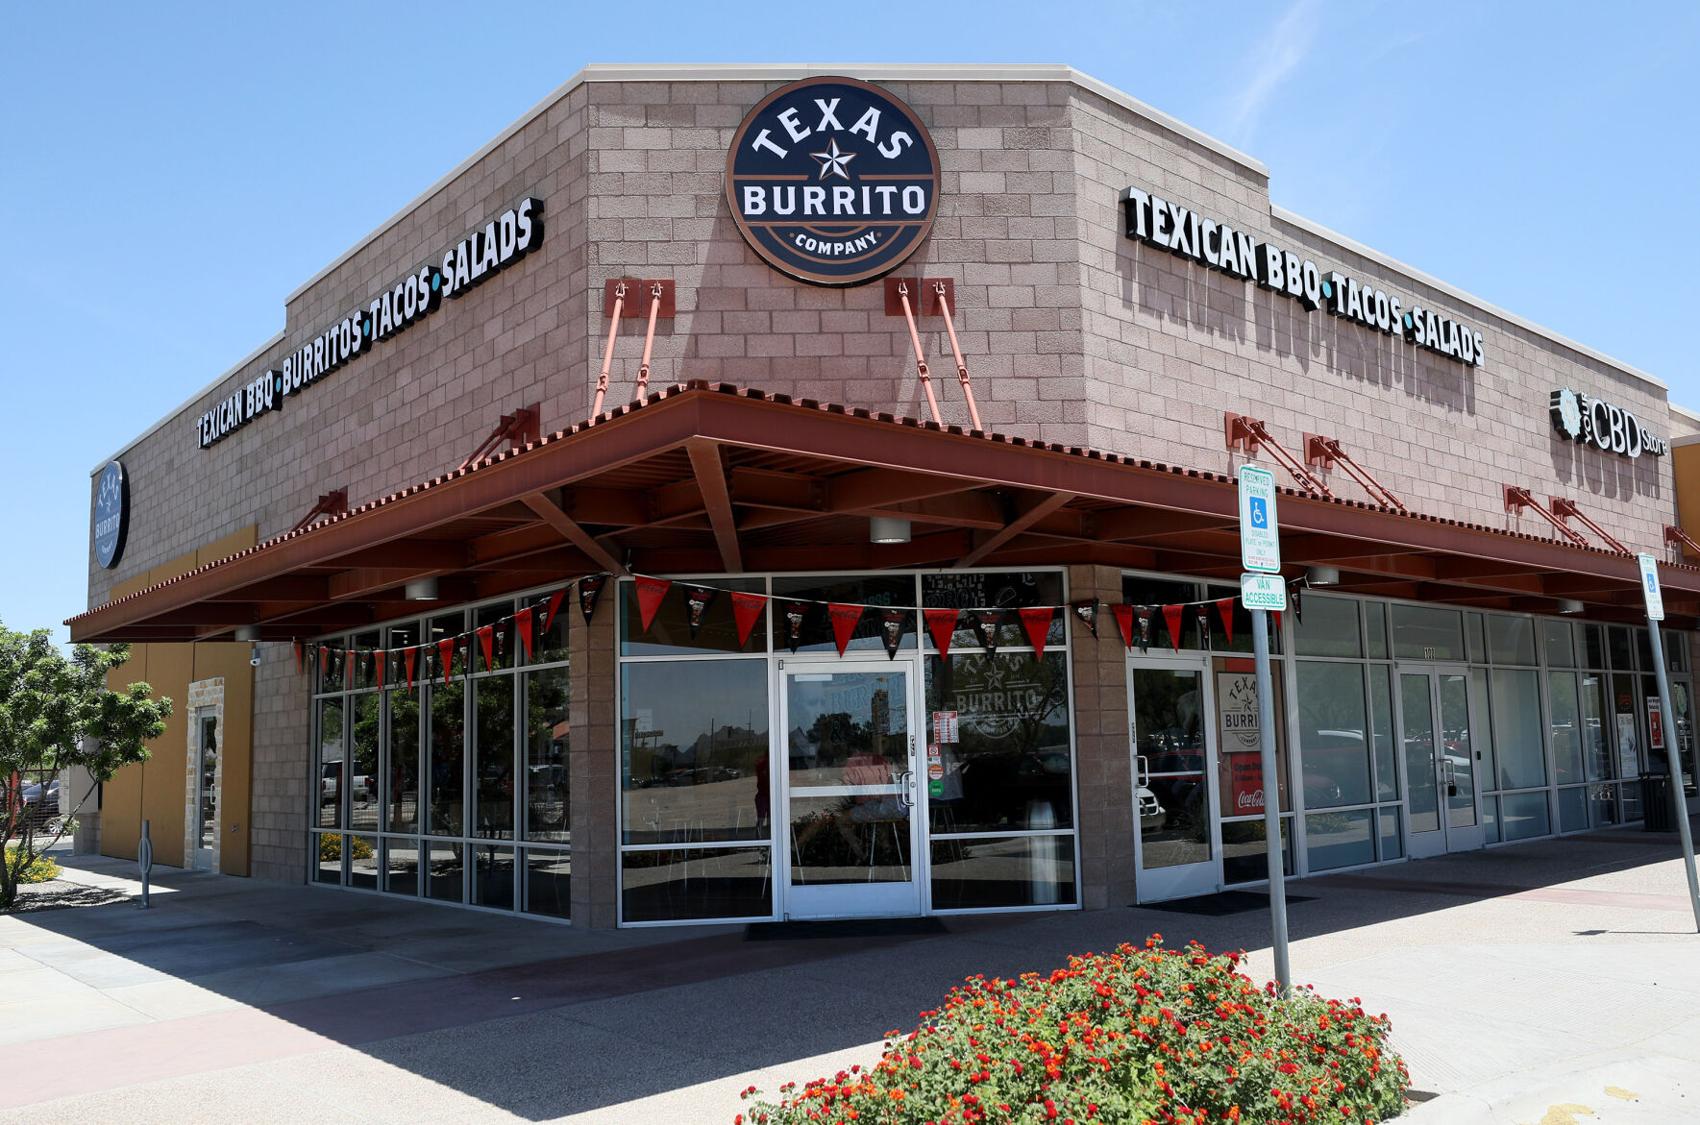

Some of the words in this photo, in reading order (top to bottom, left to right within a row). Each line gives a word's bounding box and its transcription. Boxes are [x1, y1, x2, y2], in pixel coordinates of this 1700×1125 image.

[752, 98, 914, 159] TEXAS
[743, 185, 926, 215] BURRITO
[795, 231, 878, 256] COMPANY
[1128, 186, 1258, 281] TEXICAN
[1265, 243, 1322, 310] BBQ
[1332, 272, 1402, 335] TACOS
[1411, 306, 1485, 367] SALADS
[196, 389, 243, 449] TEXICAN
[246, 370, 275, 419] BBQ
[282, 310, 362, 396] BURRITOS
[369, 266, 430, 341] TACOS
[442, 198, 534, 298] SALADS
[1591, 400, 1642, 458] CBD
[1256, 578, 1271, 590] VAN
[1245, 592, 1284, 605] ACCESSIBLE
[1229, 676, 1258, 700] TEXA
[956, 689, 1037, 713] BURRITO
[1225, 713, 1258, 728] BURRI
